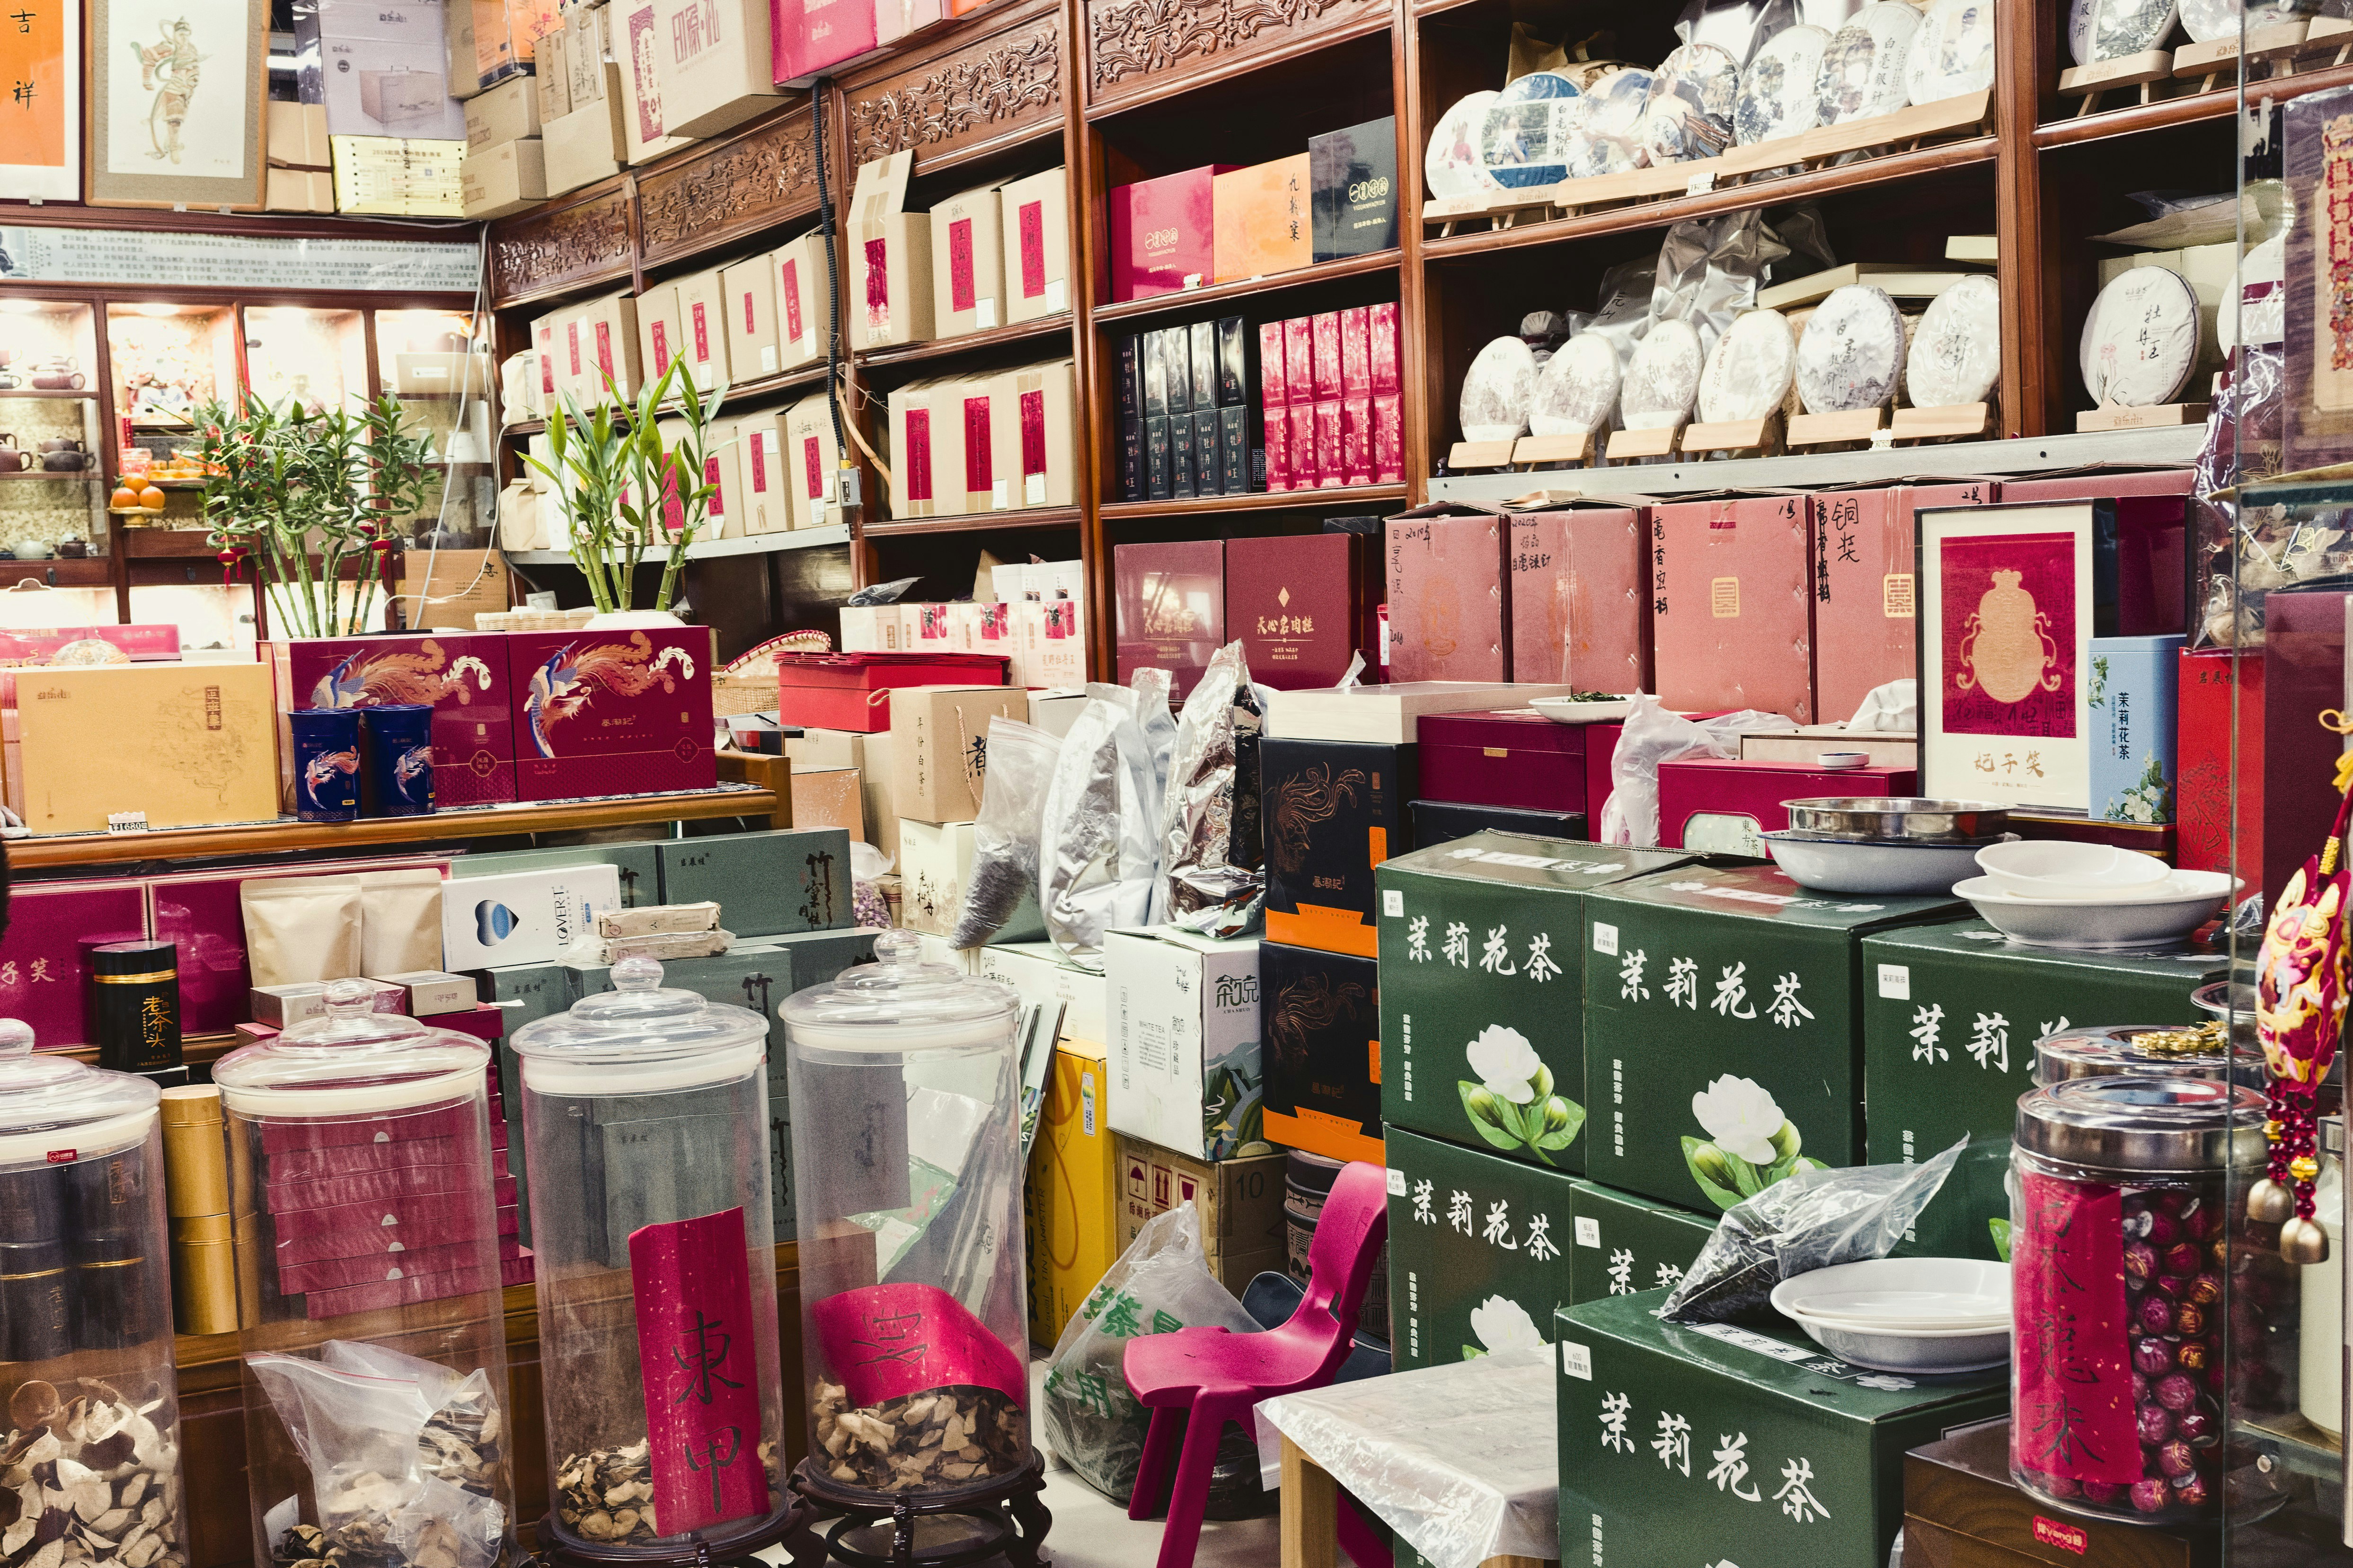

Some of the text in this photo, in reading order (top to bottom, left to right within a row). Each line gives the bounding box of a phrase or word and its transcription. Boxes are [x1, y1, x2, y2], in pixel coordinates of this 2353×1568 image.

[13, 9, 37, 112] 吉祥
[1778, 500, 1796, 520] 1号
[2118, 691, 2130, 760] 茉莉花茶
[552, 890, 569, 946] LOVER-T
[1406, 915, 1563, 983] 茉莉花茶
[143, 995, 174, 1047] 老茶头
[1619, 948, 1815, 1029] 茉莉花茶
[1236, 1171, 1265, 1201] 10
[1411, 1179, 1561, 1261] 茉莉花茶
[1598, 1391, 1831, 1524] 茉莉花茶
